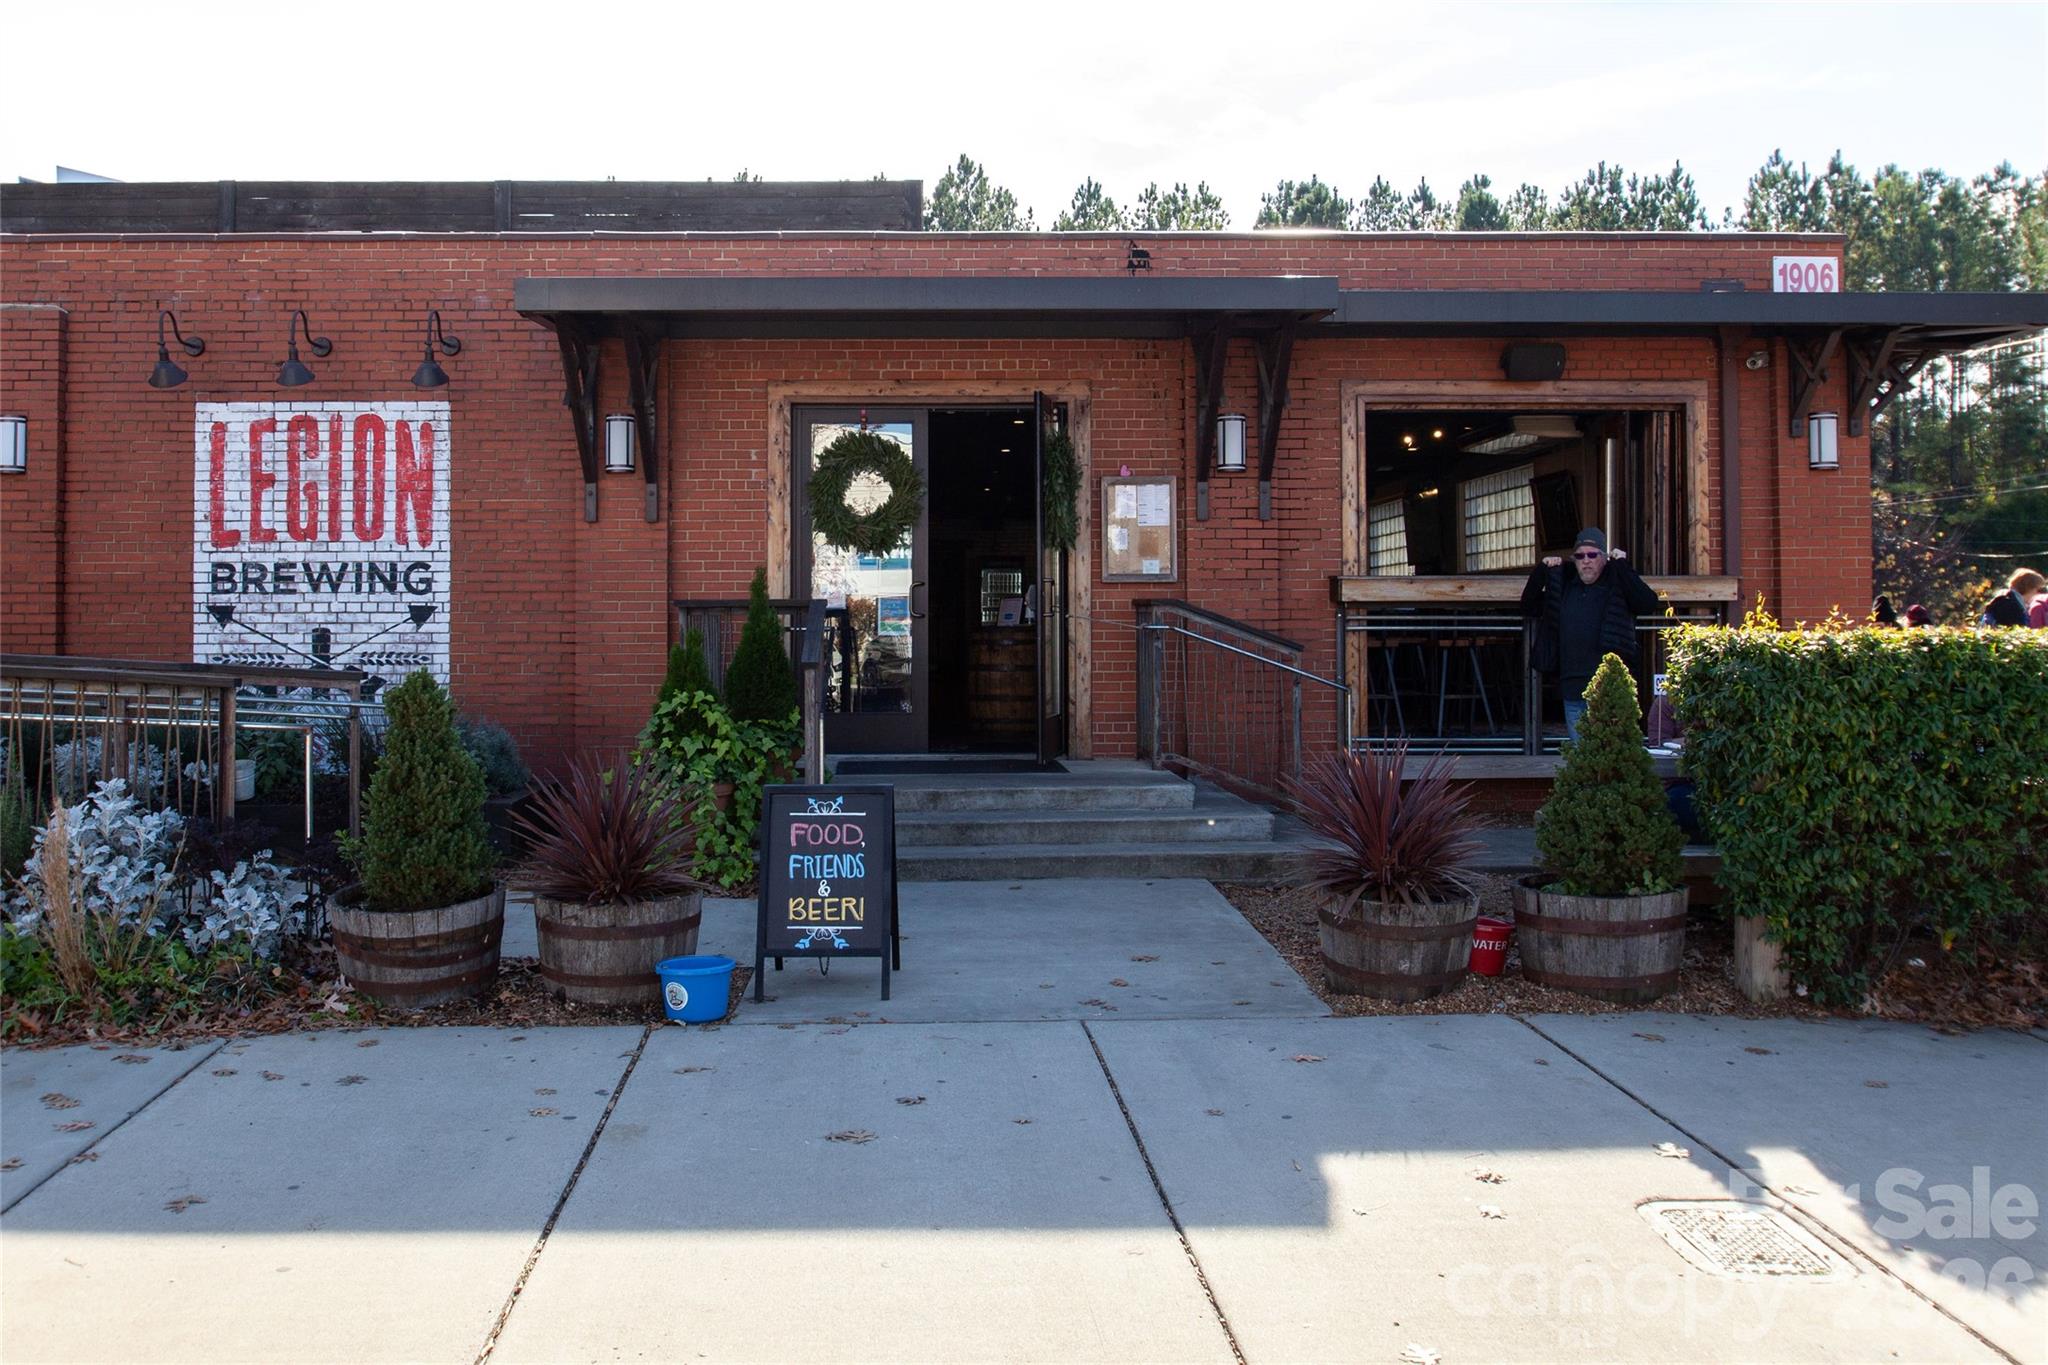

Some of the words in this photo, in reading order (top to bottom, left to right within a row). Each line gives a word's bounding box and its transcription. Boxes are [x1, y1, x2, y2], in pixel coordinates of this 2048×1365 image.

[1778, 262, 1834, 293] 1906
[210, 413, 434, 548] LEGION
[211, 561, 433, 595] BREWING
[790, 823, 866, 848] FOOD,
[788, 853, 865, 879] FRIENDS
[818, 879, 831, 897] &
[788, 896, 865, 921] BEER!
